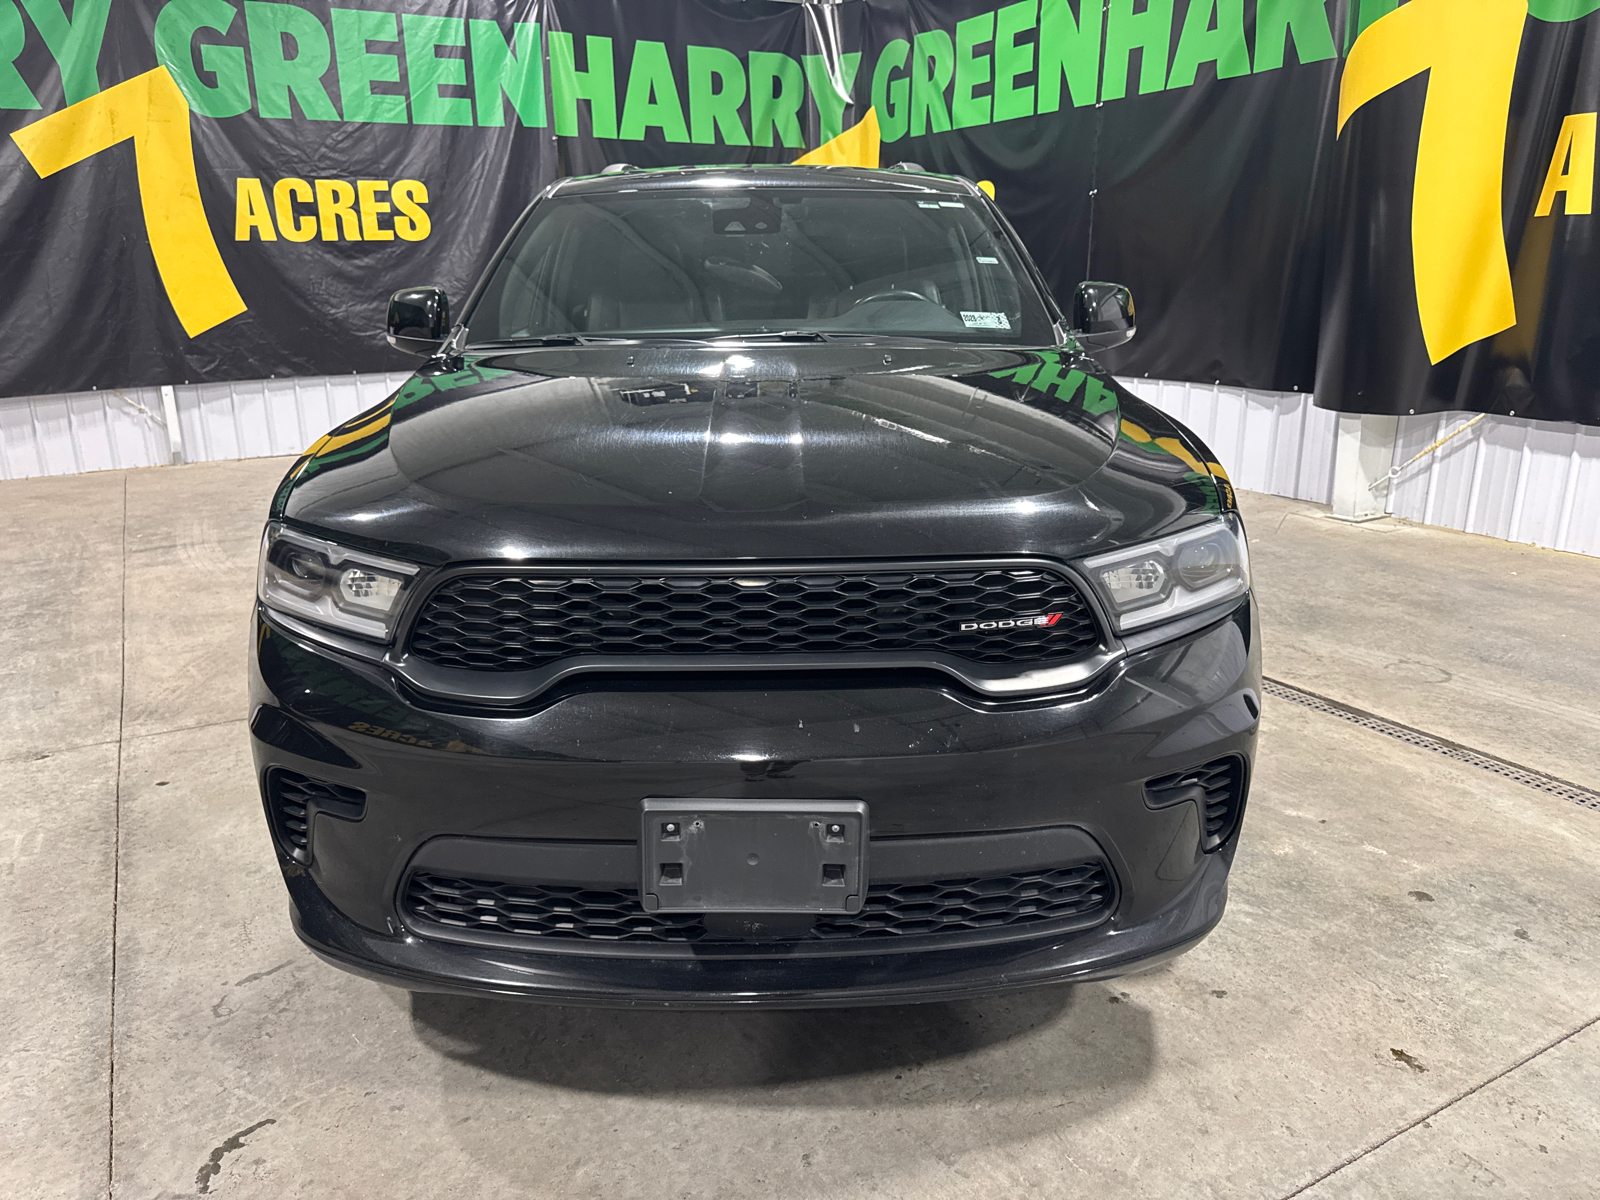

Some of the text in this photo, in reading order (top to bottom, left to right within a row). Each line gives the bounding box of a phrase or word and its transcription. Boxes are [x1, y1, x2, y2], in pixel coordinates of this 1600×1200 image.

[155, 0, 547, 127] GREEN
[548, 31, 861, 148] HARRY
[875, 0, 1101, 143] GREEN
[10, 65, 431, 338] 7 ACRES
[960, 616, 1049, 631] DODGE
